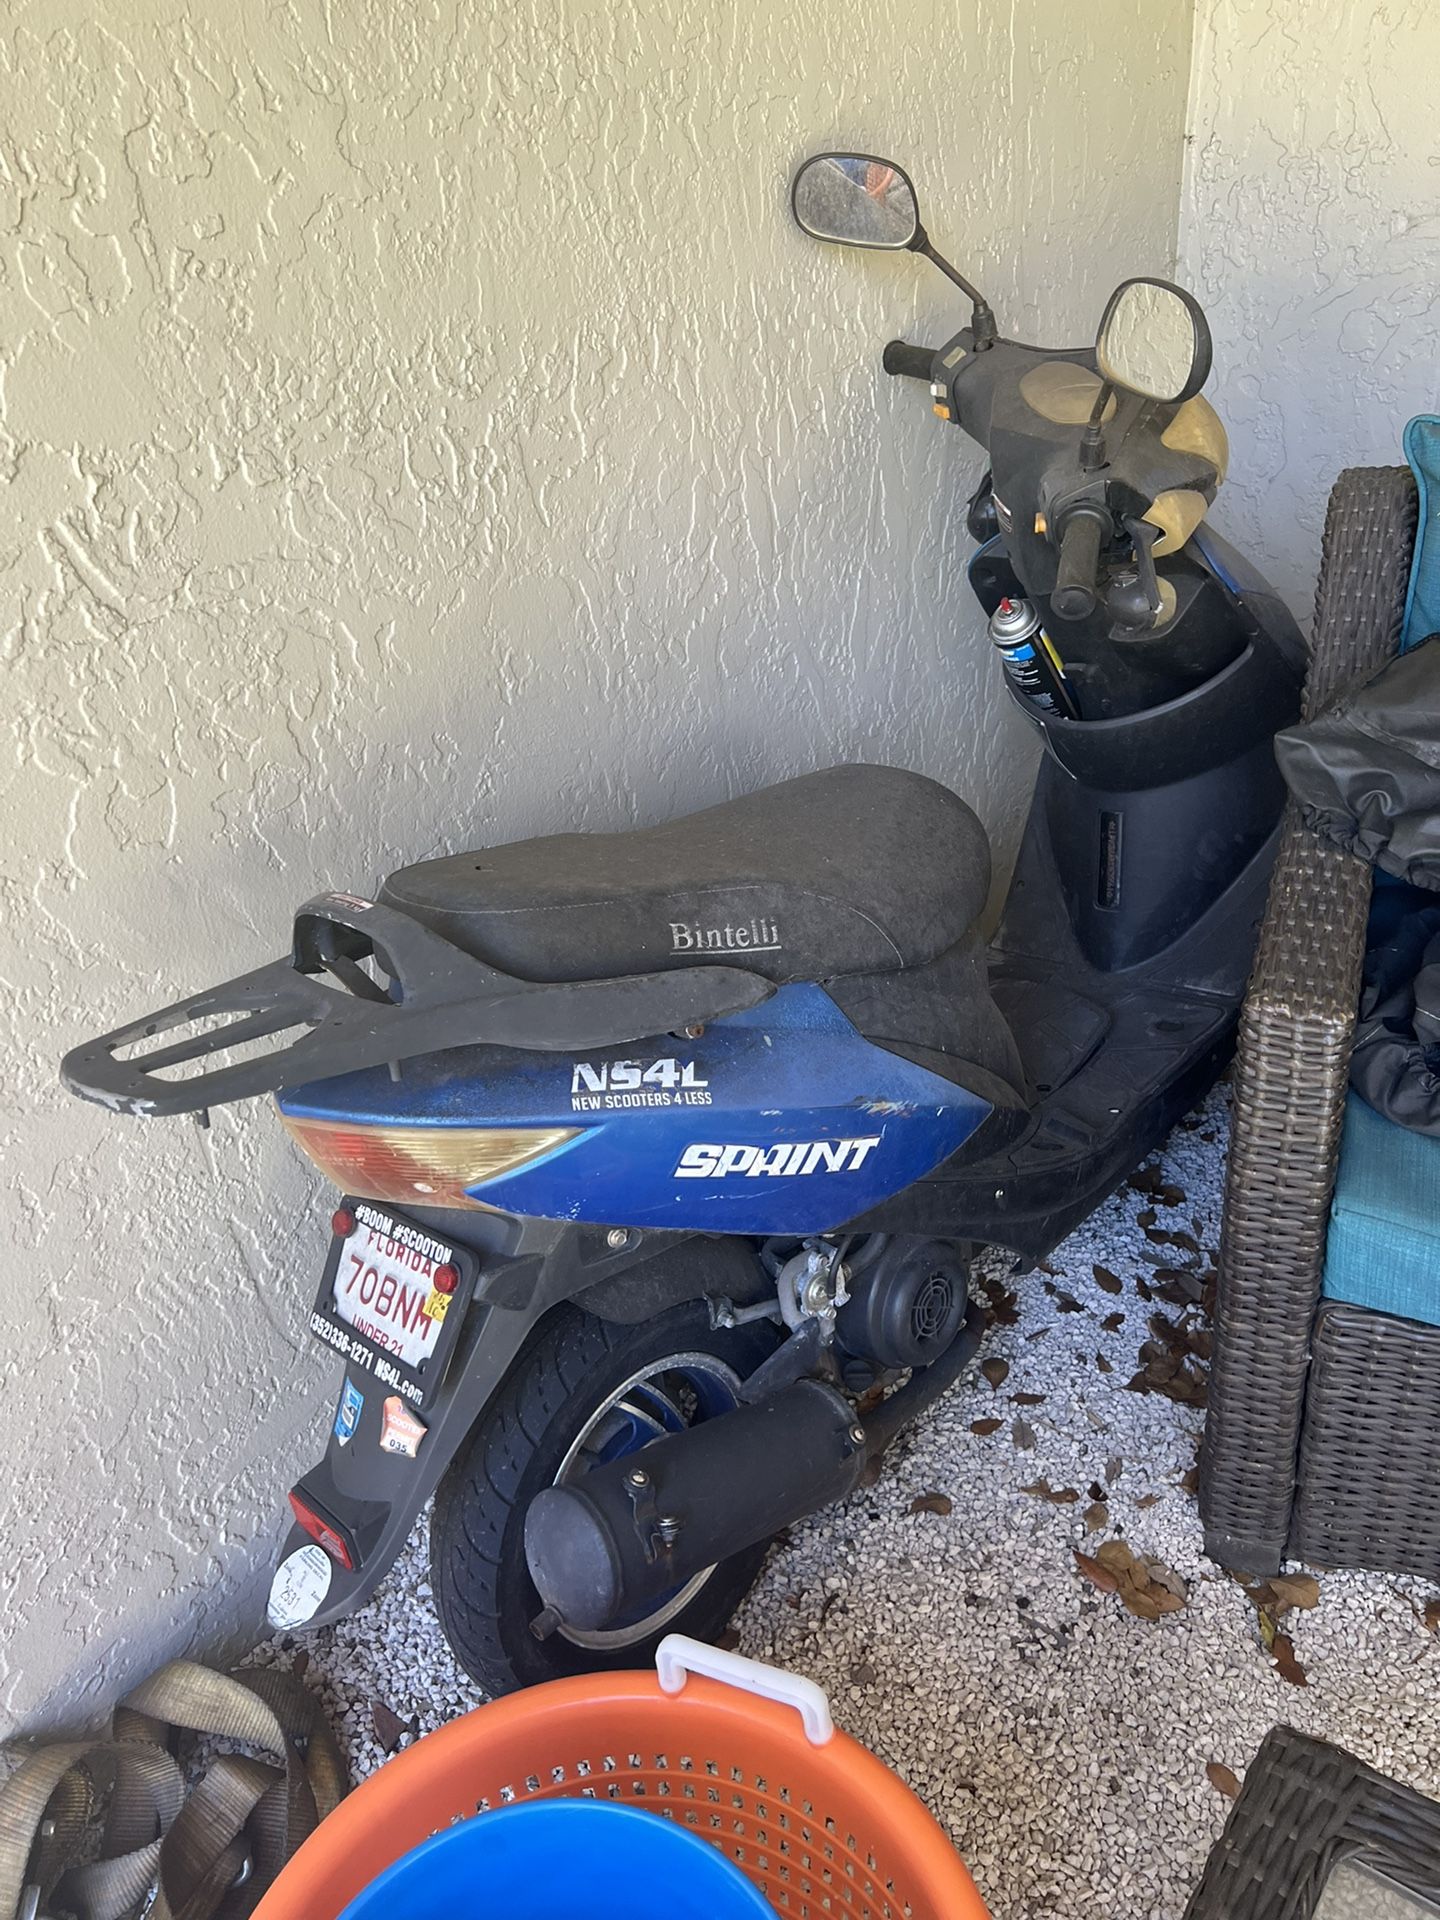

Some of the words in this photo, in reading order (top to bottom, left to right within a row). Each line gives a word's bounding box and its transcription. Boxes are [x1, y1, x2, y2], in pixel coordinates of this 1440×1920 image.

[669, 917, 778, 950] Bintelli
[571, 1058, 708, 1093] NS4L
[571, 1096, 601, 1111] NEW
[606, 1093, 671, 1109] SCOOTERS
[674, 1093, 682, 1105] 4
[685, 1091, 713, 1105] LESS
[673, 1136, 881, 1178] SPRINT
[354, 1204, 394, 1234] #BOOM
[392, 1224, 452, 1264] #SCOOTON
[367, 1231, 432, 1279] FLORIDA
[309, 1311, 374, 1369] (352)336-1271
[373, 1357, 424, 1405] NS4L.com
[389, 1439, 407, 1453] 035
